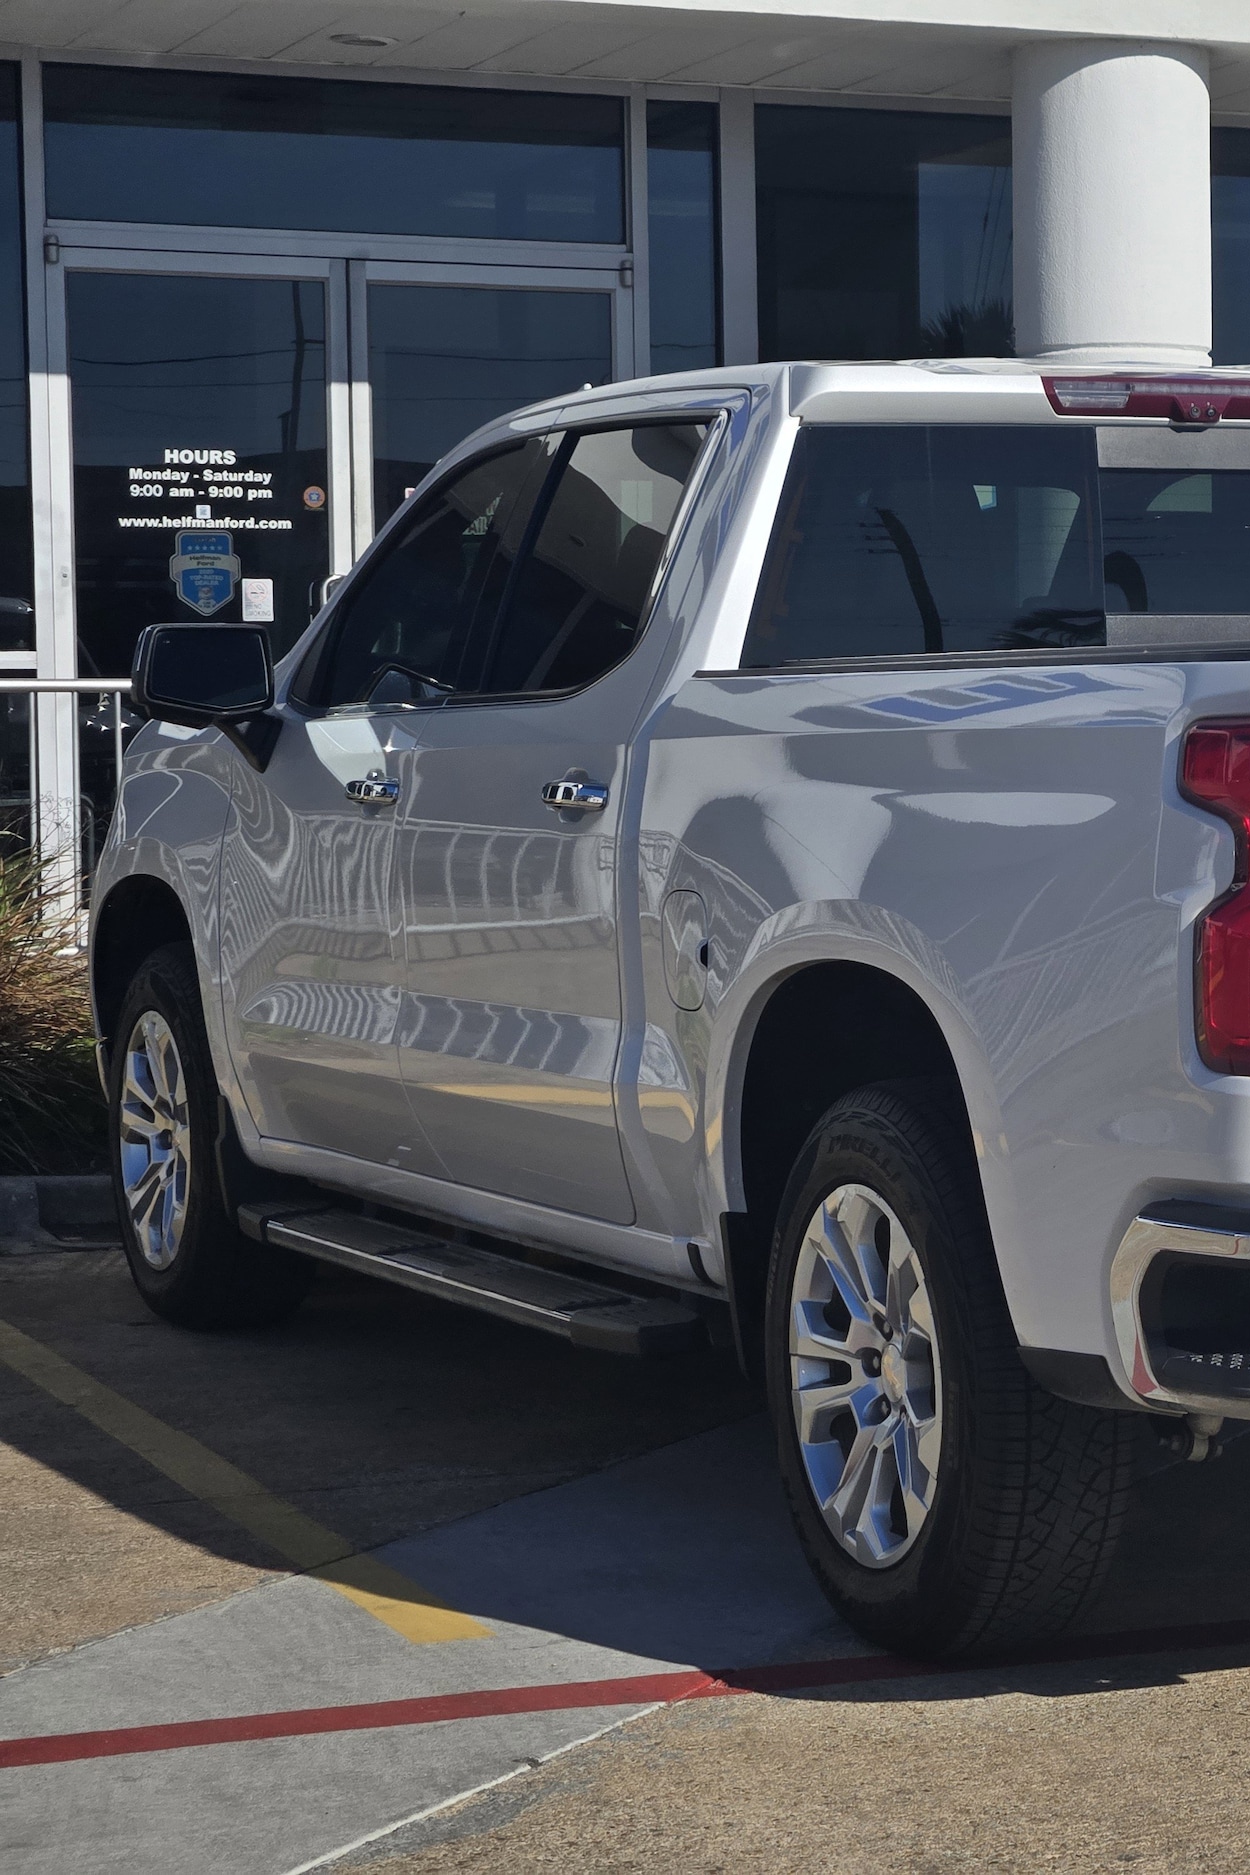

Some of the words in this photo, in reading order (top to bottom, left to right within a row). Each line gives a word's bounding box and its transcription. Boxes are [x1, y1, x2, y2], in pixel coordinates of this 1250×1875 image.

[164, 449, 236, 465] HOURS
[128, 468, 190, 483] Monday
[202, 469, 273, 485] Saturday
[130, 484, 163, 497] 9:00
[169, 487, 194, 497] am
[208, 486, 244, 498] 9:00
[246, 488, 273, 501] pm
[118, 516, 292, 529] www.helfmanford.com
